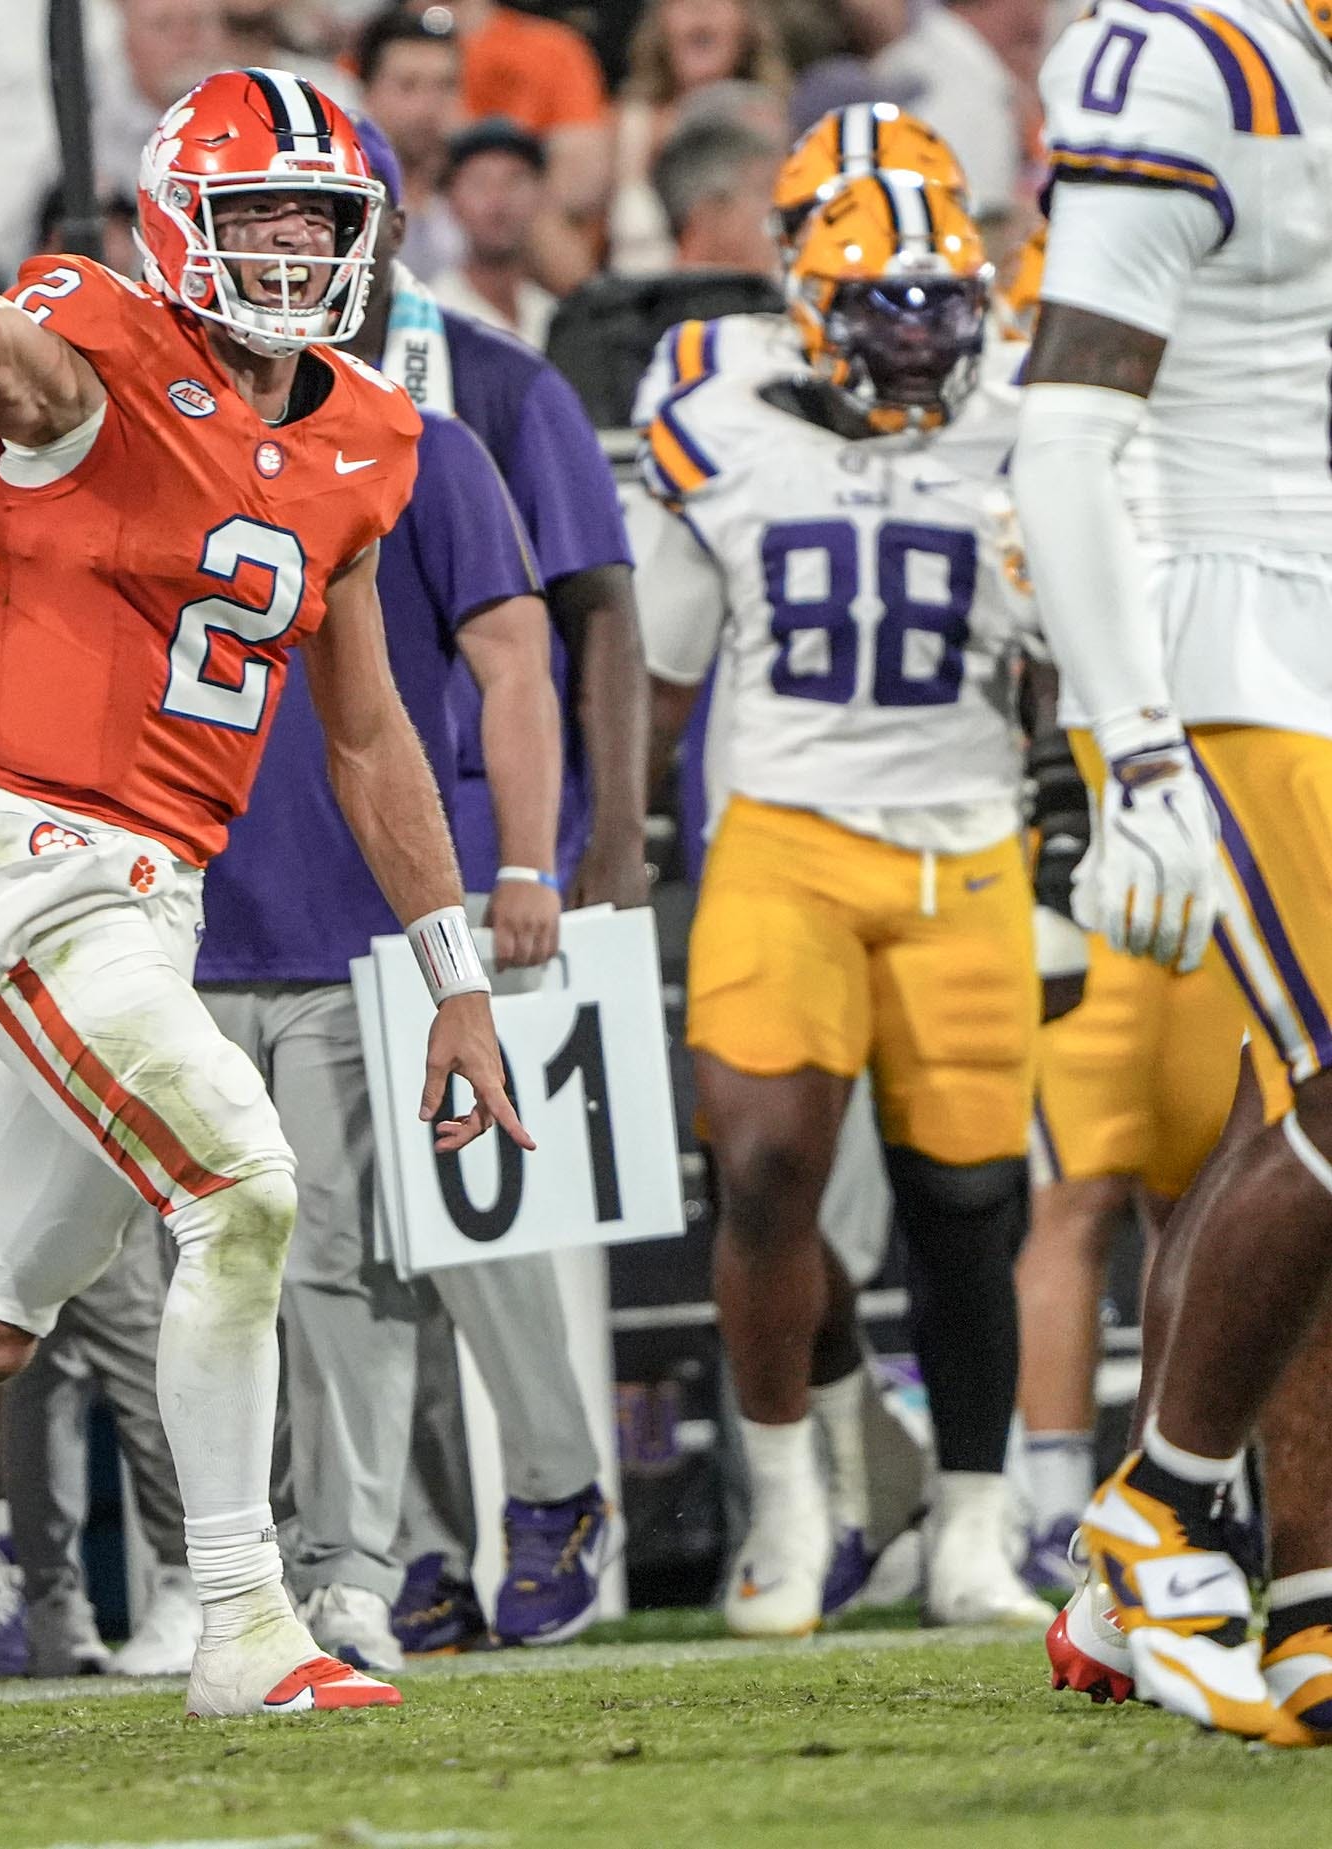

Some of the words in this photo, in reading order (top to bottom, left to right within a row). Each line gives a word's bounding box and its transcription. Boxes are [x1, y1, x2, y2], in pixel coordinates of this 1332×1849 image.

[13, 266, 83, 326] 2
[174, 387, 212, 409] ACC
[160, 513, 307, 734] 2
[761, 518, 977, 706] 88
[431, 1001, 625, 1244] 01
